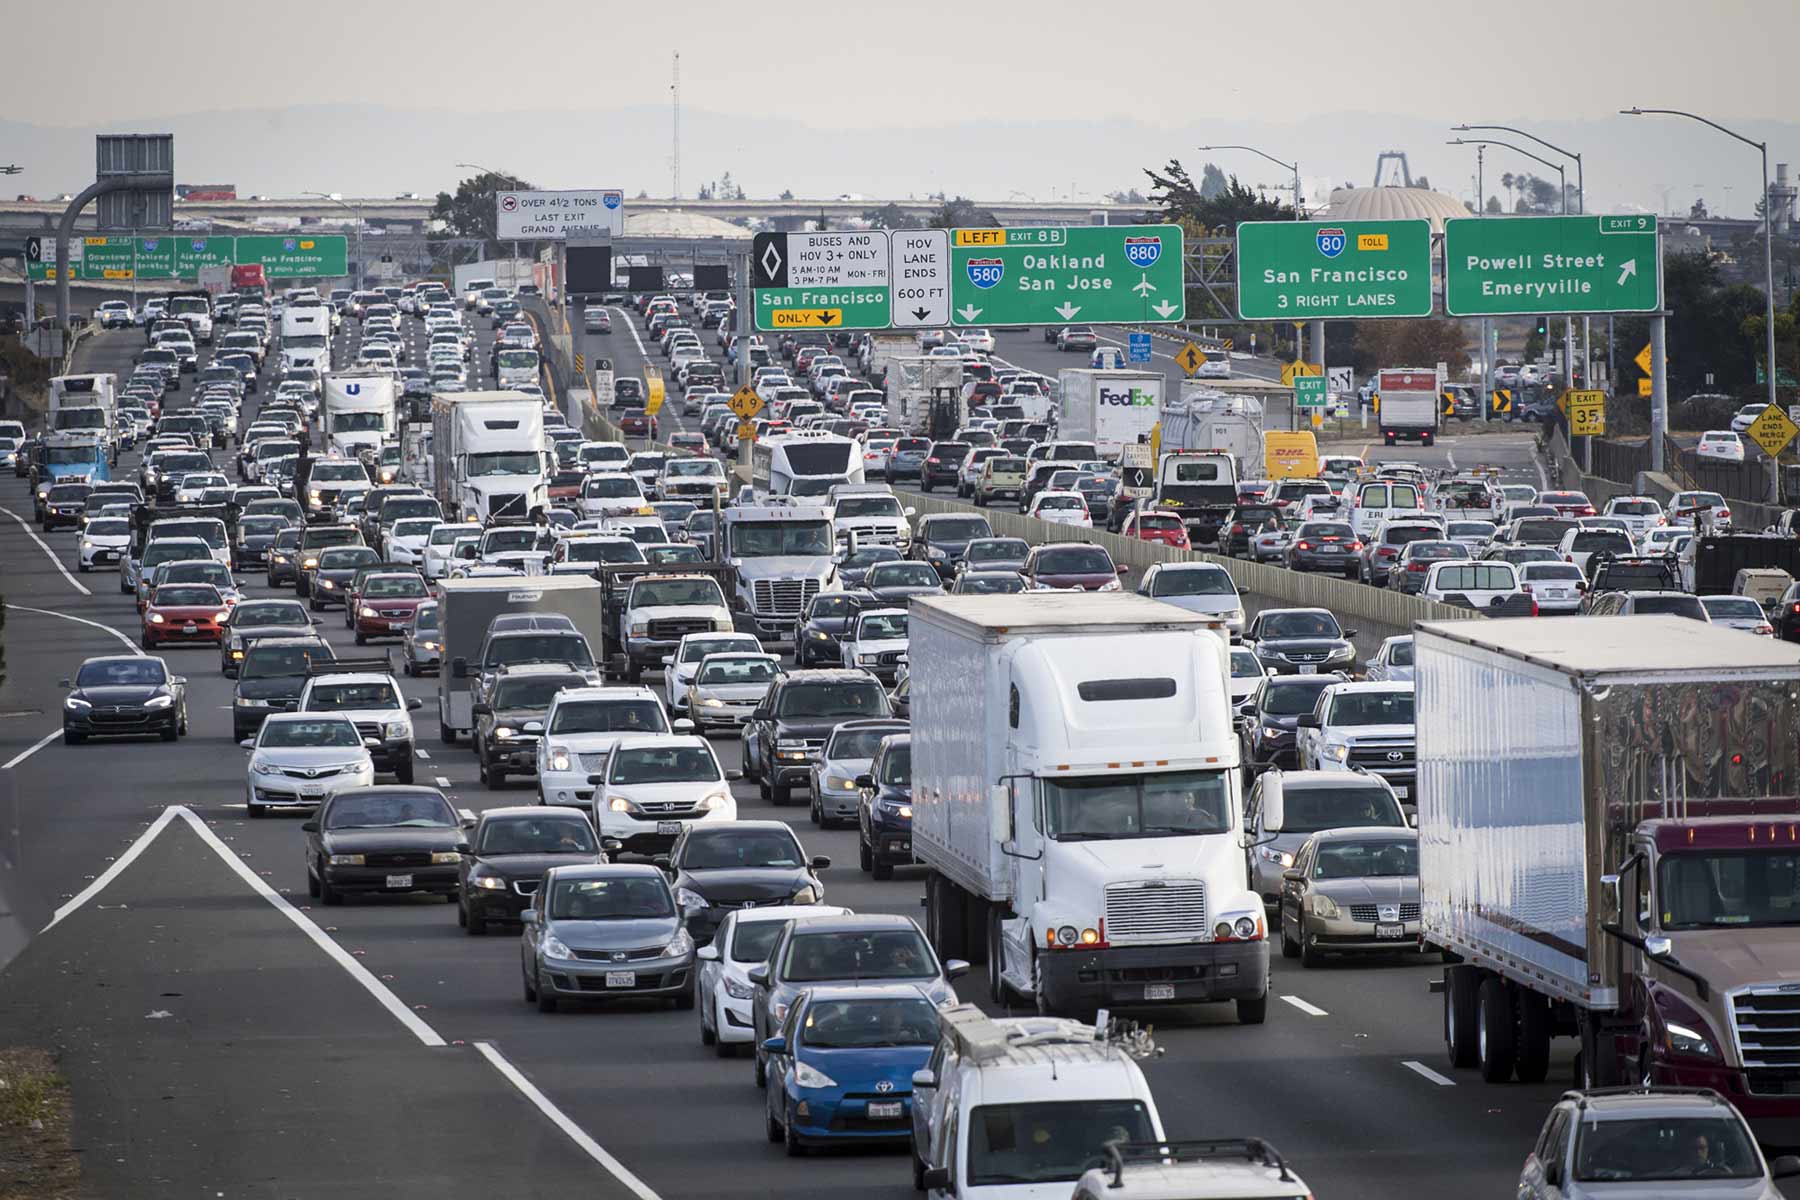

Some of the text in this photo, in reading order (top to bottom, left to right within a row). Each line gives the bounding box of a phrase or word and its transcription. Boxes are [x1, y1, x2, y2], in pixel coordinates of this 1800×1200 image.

[521, 199, 545, 207] OVER
[574, 198, 598, 206] TONS
[534, 214, 585, 222] LAST EXIT
[1610, 218, 1646, 229] EXIT 9
[808, 236, 871, 247] BUSES AND
[962, 232, 1000, 244] LEFT
[1010, 232, 1032, 242] EXIT
[1362, 238, 1384, 246] TOLL
[906, 240, 932, 248] HOV
[1322, 237, 1342, 252] 80
[800, 252, 821, 261] HOV
[848, 250, 877, 260] ONLY
[1129, 246, 1158, 260] 880
[904, 254, 936, 264] LANE
[1023, 254, 1105, 270] Oakland
[1466, 253, 1604, 270] Powell Street
[792, 266, 798, 275] 5
[828, 266, 841, 274] AM
[904, 269, 937, 278] ENDS
[972, 268, 1000, 282] 580
[1264, 266, 1408, 284] San Francisco
[794, 276, 800, 285] 3
[826, 276, 839, 285] PM
[1018, 276, 1113, 292] San Jose
[898, 288, 944, 299] 600 FT
[1482, 279, 1592, 298] Emeryville
[762, 291, 884, 306] San Francisco
[1278, 294, 1396, 308] 3 RIGHT LANES
[778, 314, 811, 324] ONLY
[1300, 380, 1322, 390] EXIT
[1100, 388, 1154, 406] FedEx
[1304, 394, 1311, 403] 9
[1576, 394, 1597, 402] EXIT
[1576, 409, 1600, 424] 35
[1762, 440, 1782, 448] LEFT
[1275, 448, 1305, 456] DHL
